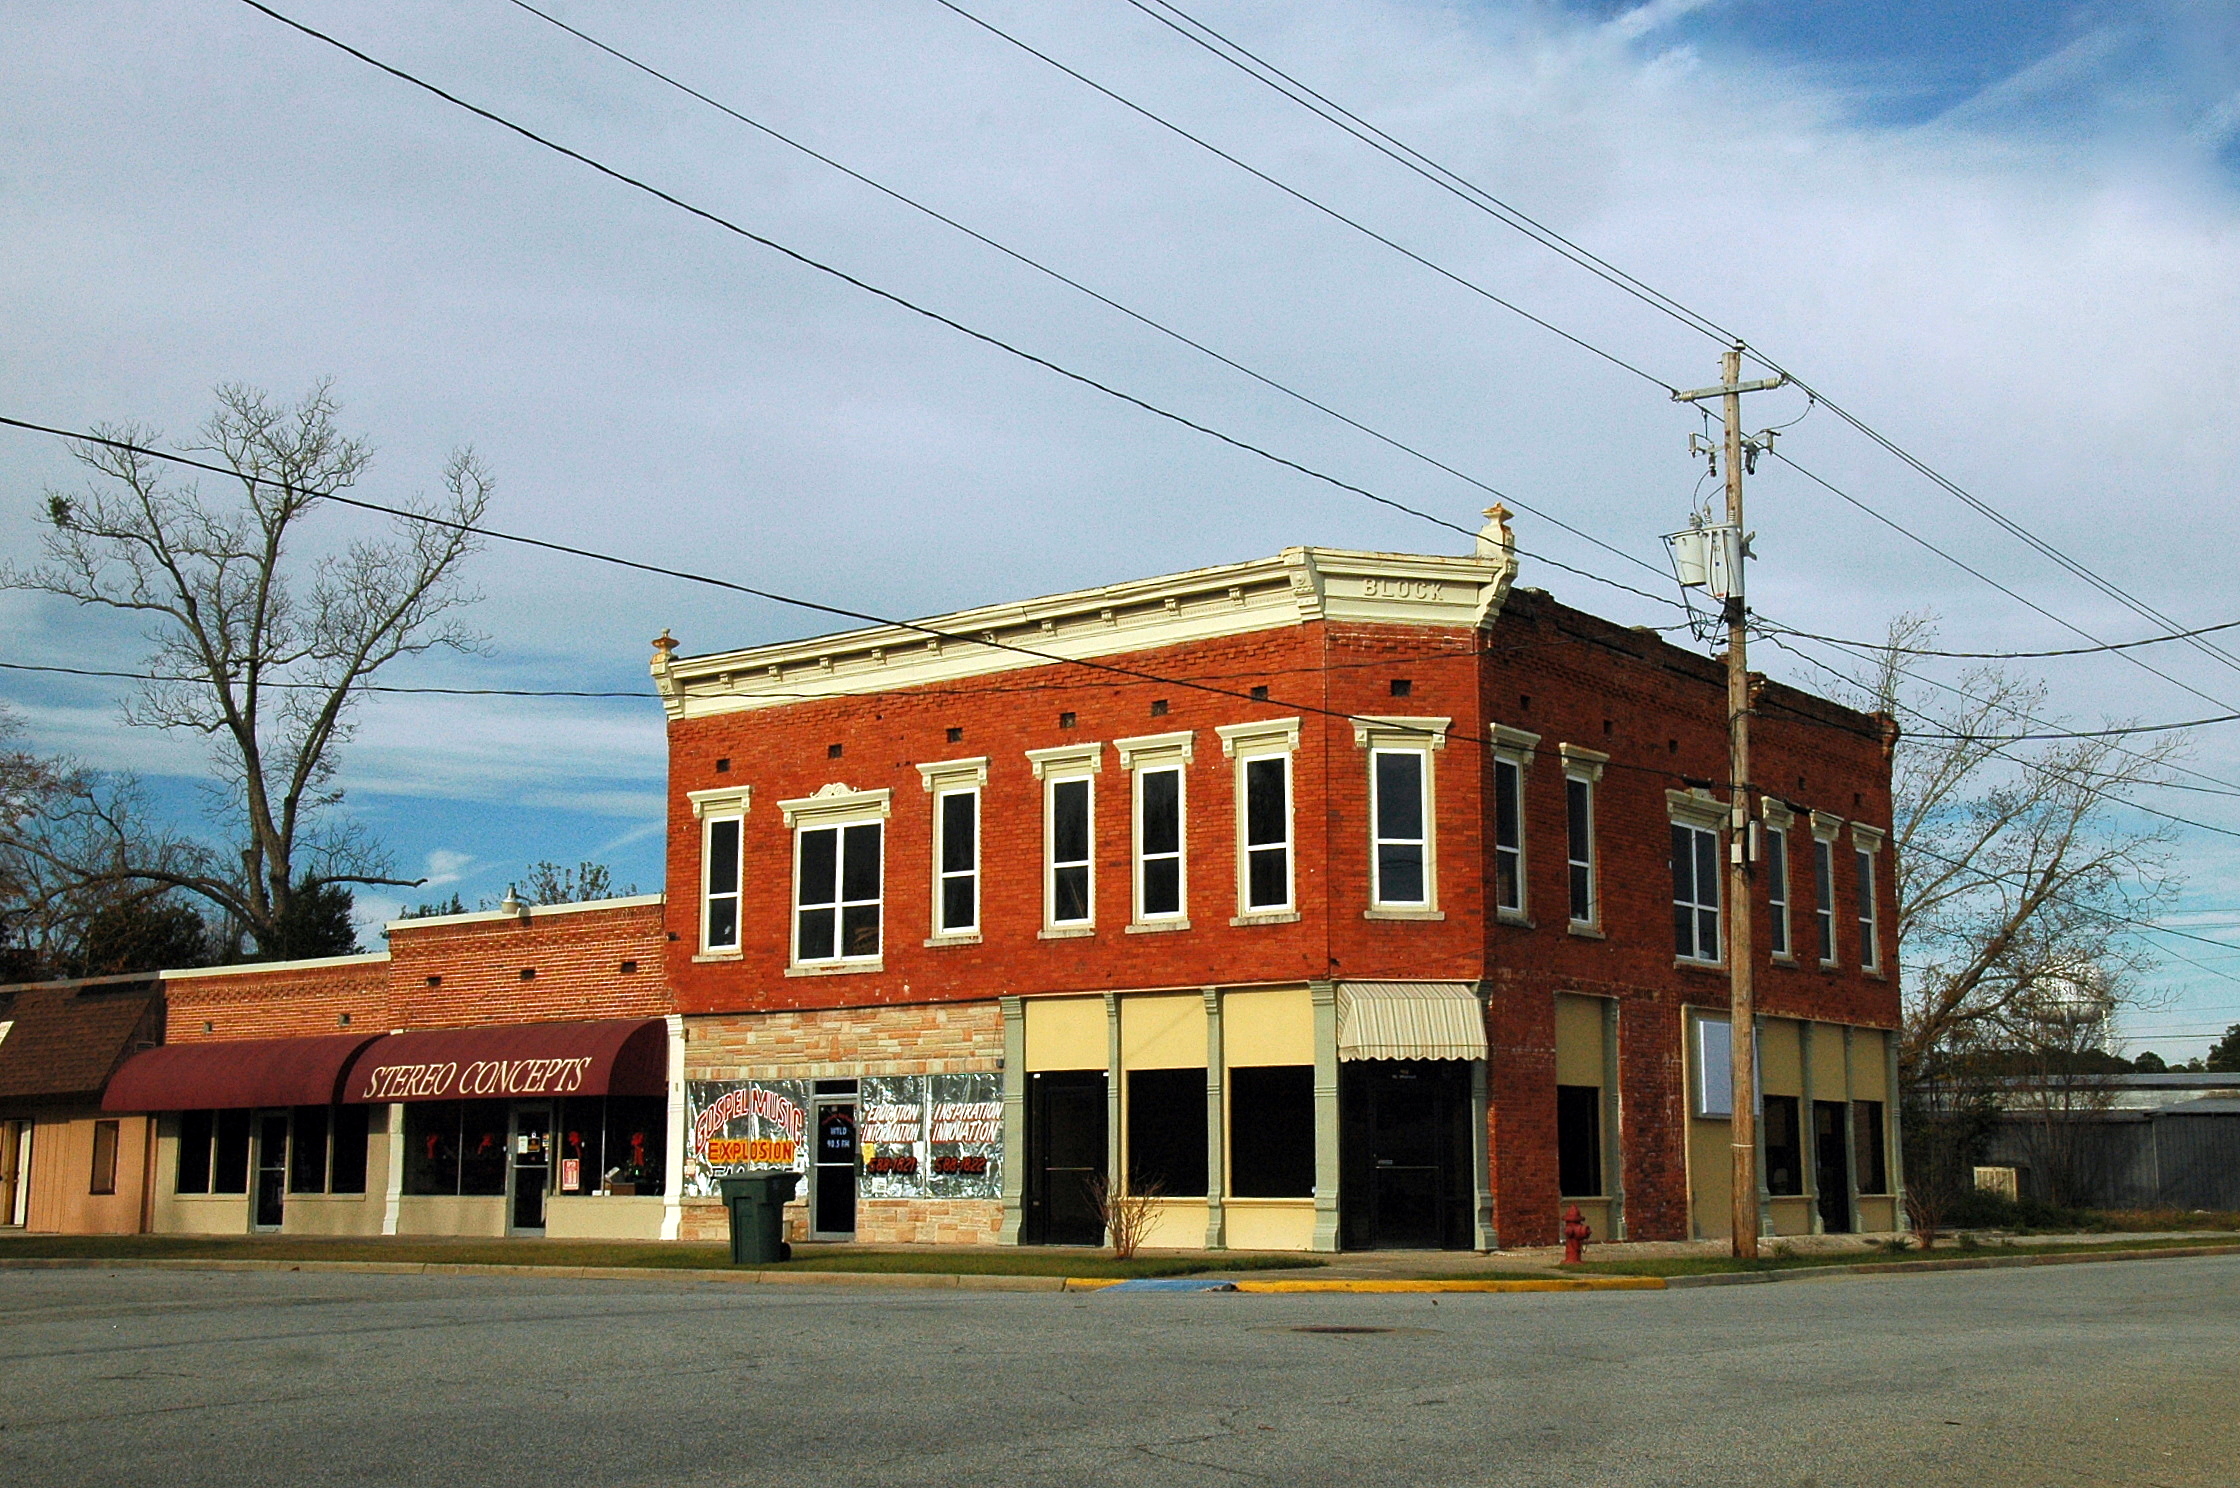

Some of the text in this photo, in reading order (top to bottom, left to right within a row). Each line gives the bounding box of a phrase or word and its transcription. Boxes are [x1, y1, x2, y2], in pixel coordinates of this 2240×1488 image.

[1364, 579, 1443, 601] BLOCK
[363, 1056, 592, 1099] STEREO CONCEPTS
[694, 1088, 804, 1156] GOSPEL MUSIC
[867, 1104, 920, 1122] EDUCATION
[933, 1102, 1004, 1121] INSPIRATION
[861, 1122, 921, 1143] INFORMATION
[932, 1121, 1000, 1142] INNOVATION
[707, 1141, 795, 1162] EXPLOSION
[867, 1157, 918, 1174] 588-1821
[935, 1157, 987, 1173] 588-1822
